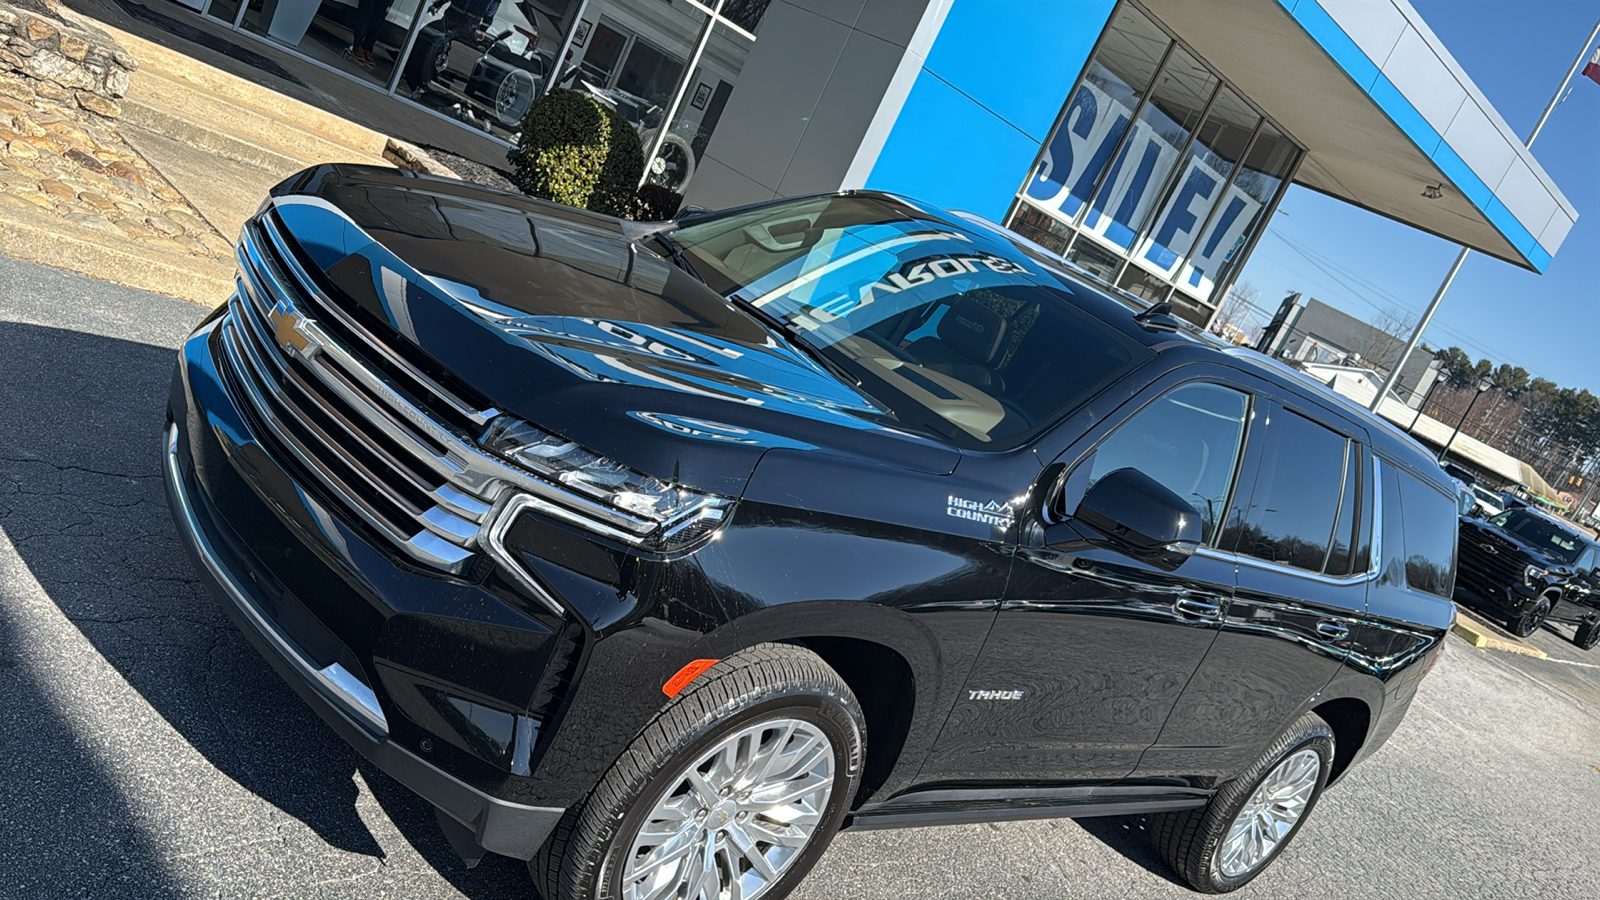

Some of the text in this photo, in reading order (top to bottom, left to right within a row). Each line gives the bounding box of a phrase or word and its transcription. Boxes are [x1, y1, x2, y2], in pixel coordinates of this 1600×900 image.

[1026, 84, 1247, 289] SALE!
[377, 385, 451, 443] HIGH COUNTRY
[947, 495, 984, 512] HIGH
[946, 507, 1015, 528] COUNTRY
[968, 690, 1025, 700] TAHOE
